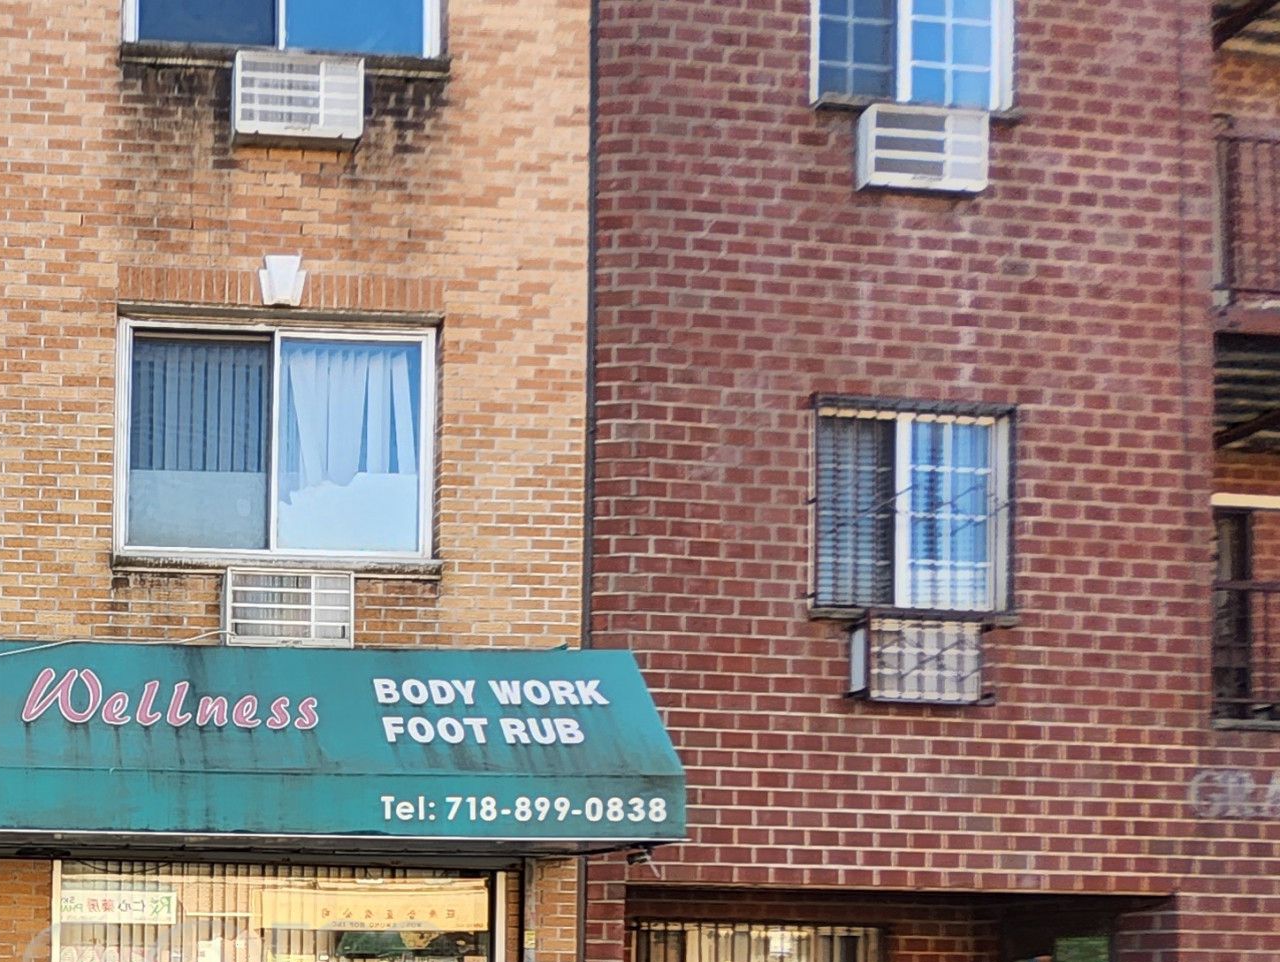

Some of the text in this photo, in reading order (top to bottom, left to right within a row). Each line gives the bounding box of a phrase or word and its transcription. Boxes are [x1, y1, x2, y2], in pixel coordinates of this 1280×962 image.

[22, 667, 319, 730] Wellness
[373, 678, 610, 706] BODY WORK
[382, 716, 584, 745] FOOT RUB
[380, 796, 667, 822] Tel: 718-899-0838
